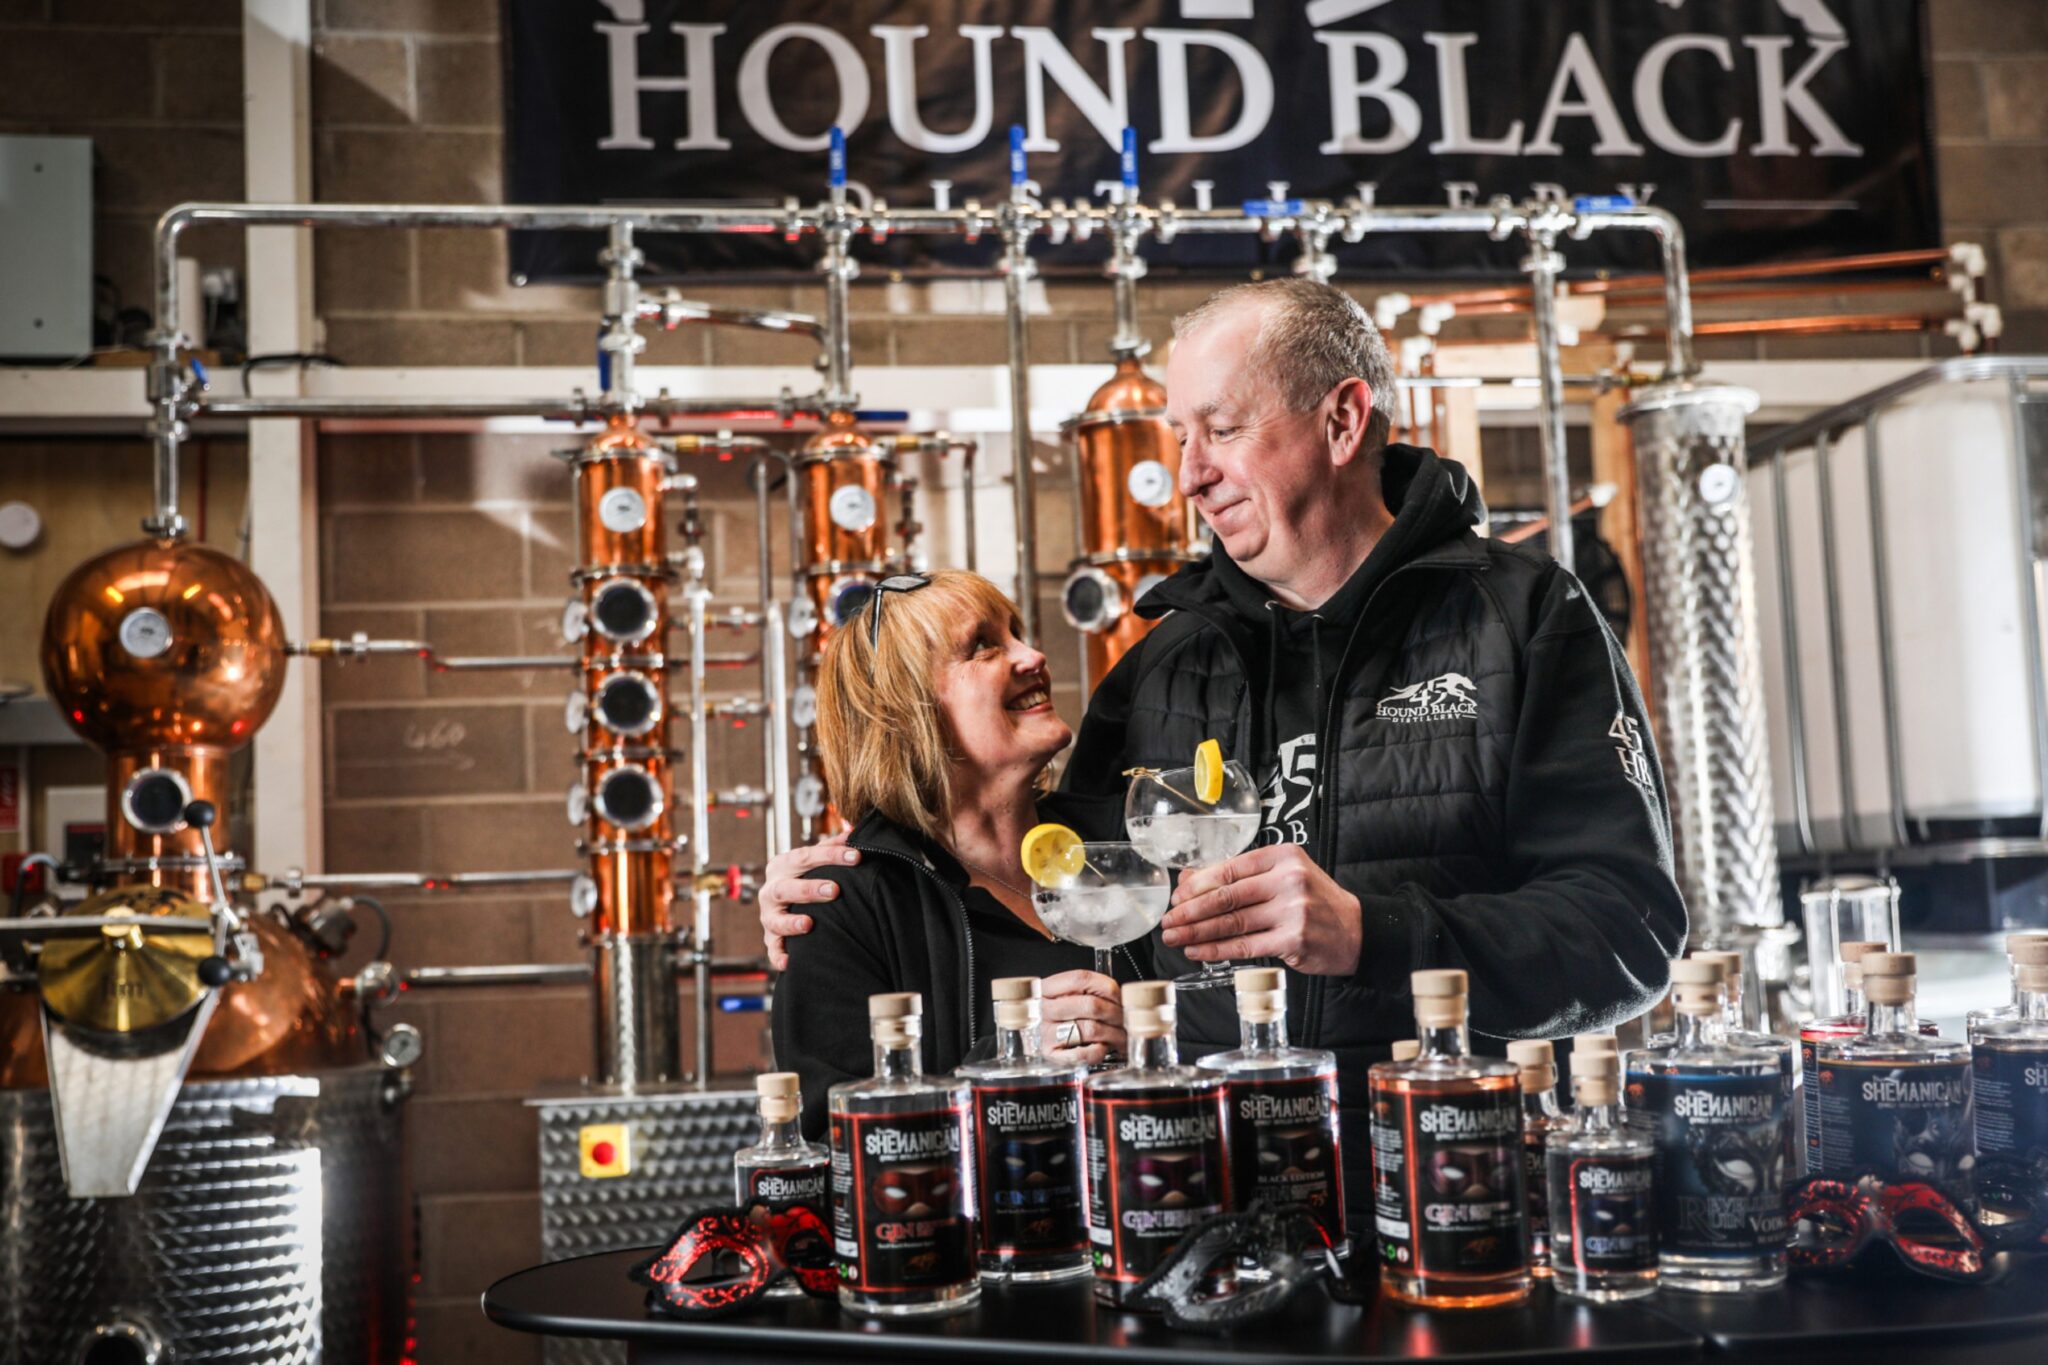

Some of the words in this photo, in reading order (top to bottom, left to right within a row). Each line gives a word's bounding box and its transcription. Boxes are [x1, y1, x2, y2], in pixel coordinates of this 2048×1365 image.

[594, 22, 1274, 154] HOUND
[1314, 31, 1864, 157] BLACK
[1376, 706, 1429, 718] HOUND
[1430, 703, 1477, 715] BLACK
[1392, 713, 1462, 723] DISTILLERY
